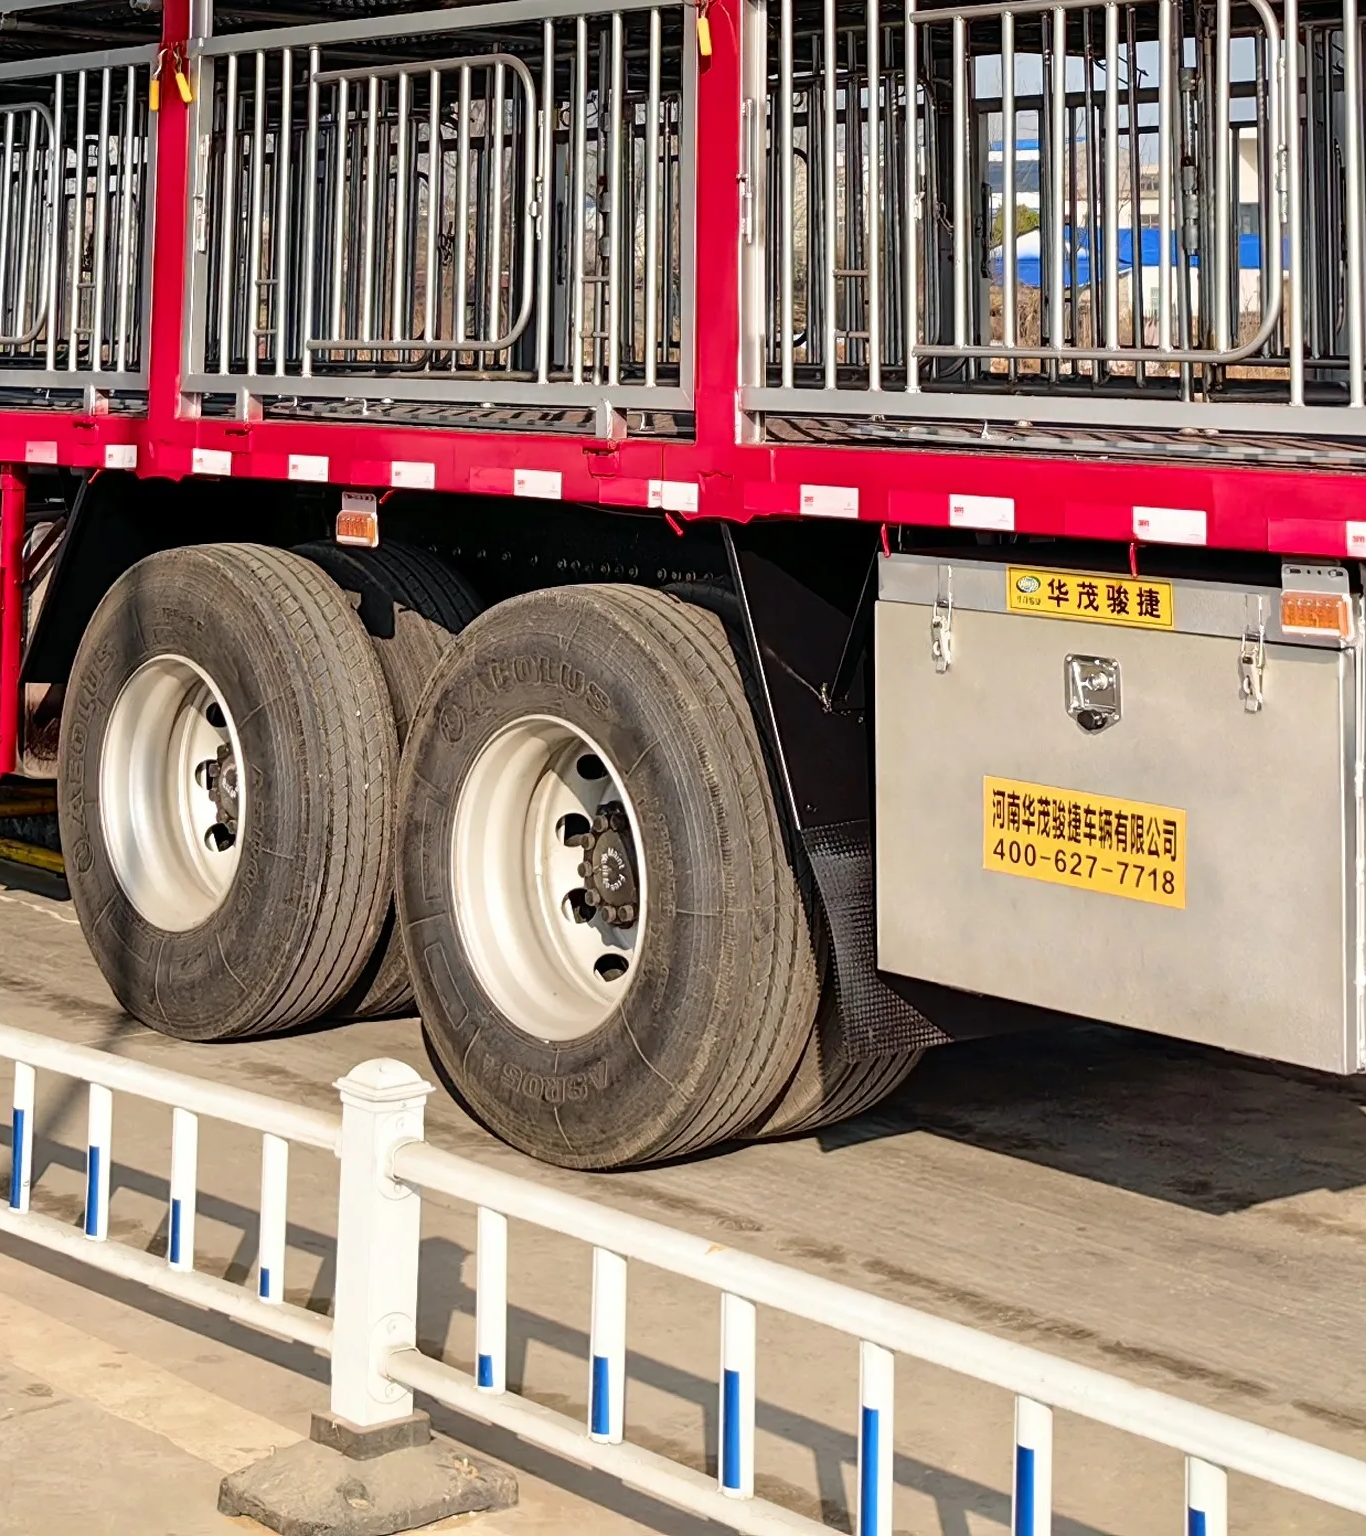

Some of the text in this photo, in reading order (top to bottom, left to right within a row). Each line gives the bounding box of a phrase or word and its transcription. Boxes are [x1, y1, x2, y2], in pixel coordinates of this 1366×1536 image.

[1047, 578, 1161, 619] 华茂骏捷
[992, 788, 1177, 862] 河南华茂骏捷车辆有限公司
[993, 838, 1175, 895] 400-627-7718
